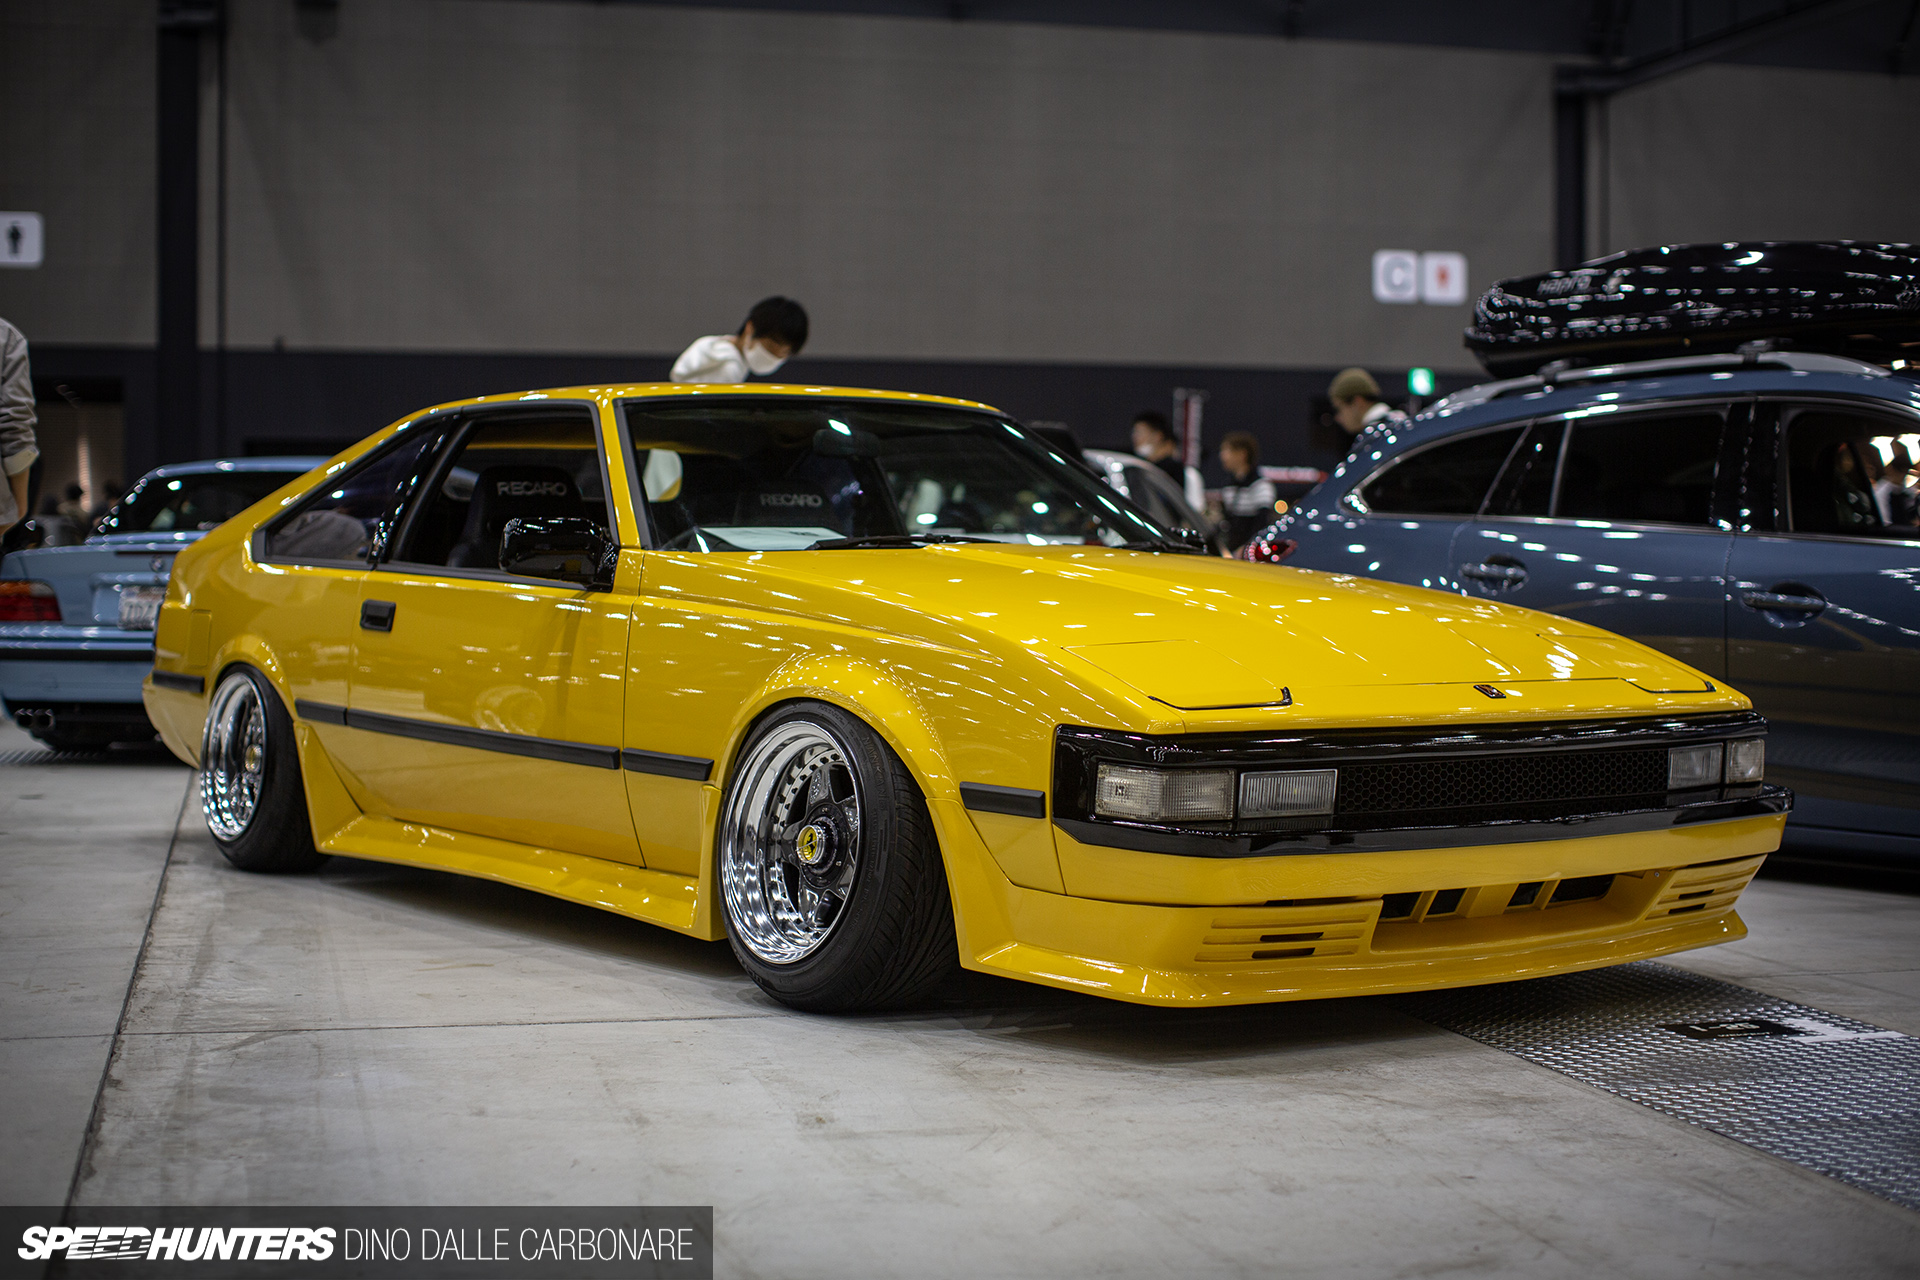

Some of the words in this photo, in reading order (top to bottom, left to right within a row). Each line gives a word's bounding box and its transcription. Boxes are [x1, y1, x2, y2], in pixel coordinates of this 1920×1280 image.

[1383, 256, 1412, 294] C
[496, 481, 567, 496] RECARO
[760, 493, 823, 508] RECARO
